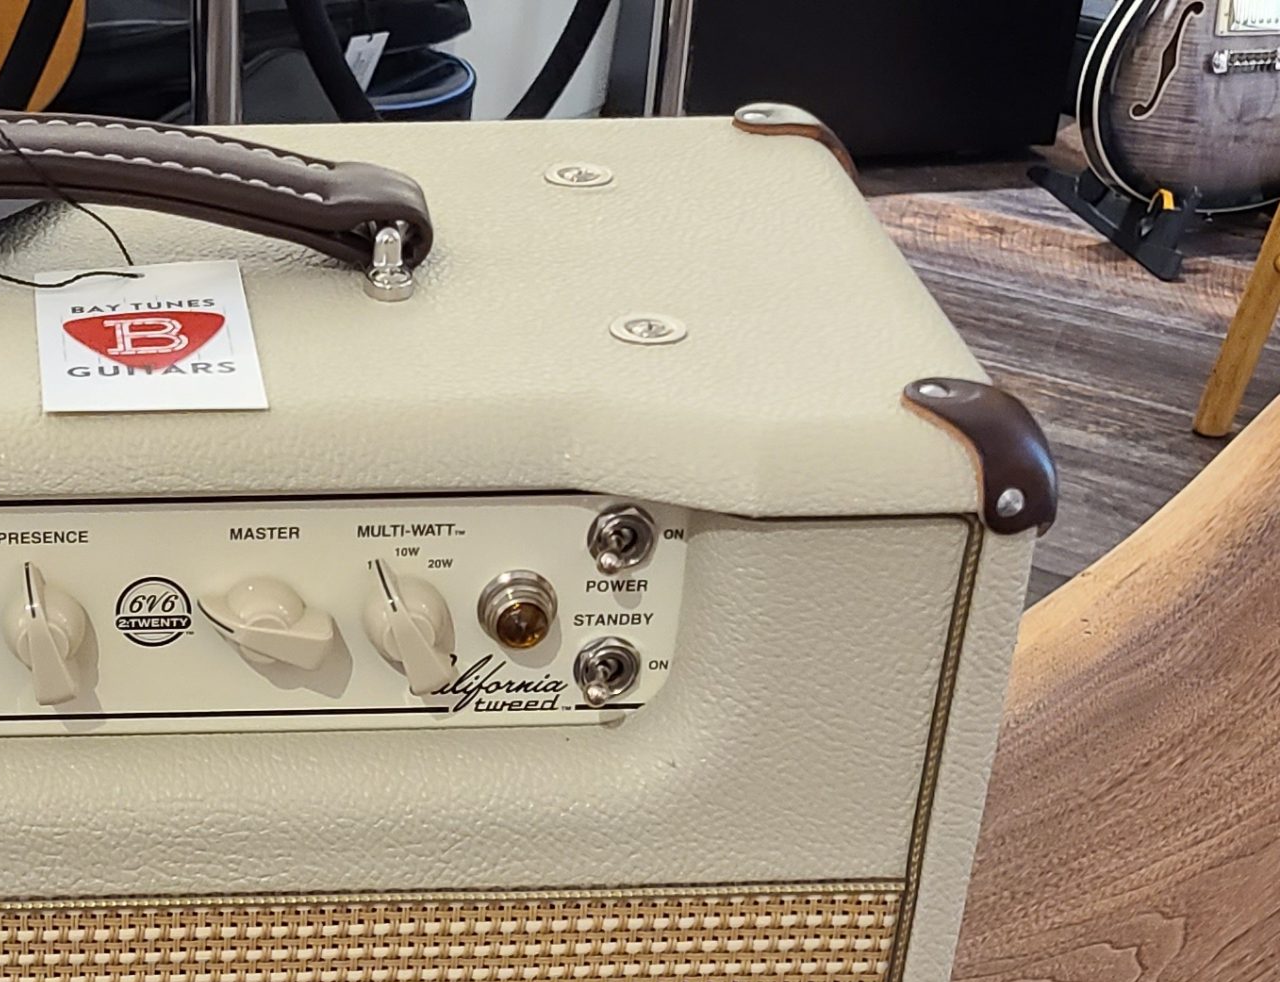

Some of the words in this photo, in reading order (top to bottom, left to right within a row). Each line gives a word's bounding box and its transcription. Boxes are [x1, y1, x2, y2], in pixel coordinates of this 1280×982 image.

[71, 303, 119, 314] BAY
[130, 298, 215, 311] TUNES
[229, 527, 300, 541] MASTER
[663, 529, 684, 541] ON
[394, 547, 420, 557] 10W
[428, 558, 453, 569] 20W
[586, 579, 648, 593] POWER
[129, 591, 179, 613] 6V6
[118, 618, 188, 628] 2:TWENTY
[573, 613, 654, 627] STANDBY
[648, 660, 669, 670] ON
[410, 653, 568, 713] lifornia
[474, 694, 560, 712] tweed
